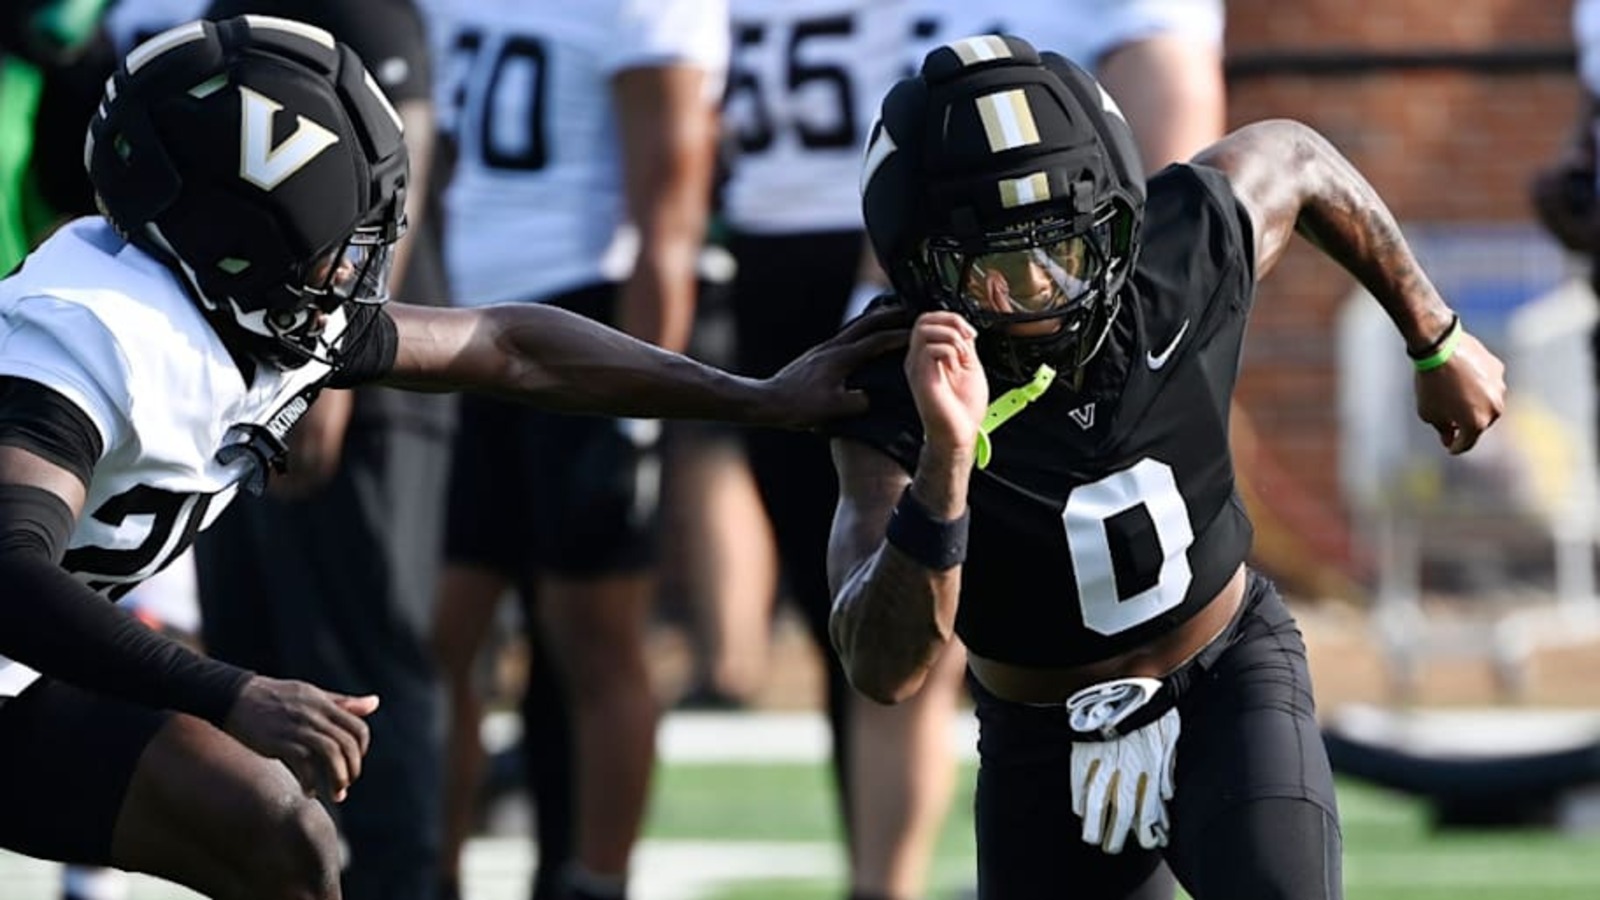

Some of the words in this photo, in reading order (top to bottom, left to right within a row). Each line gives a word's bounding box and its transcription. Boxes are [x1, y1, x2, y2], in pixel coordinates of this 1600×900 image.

[239, 86, 339, 191] V
[1068, 403, 1095, 430] V
[1062, 457, 1195, 636] 0
